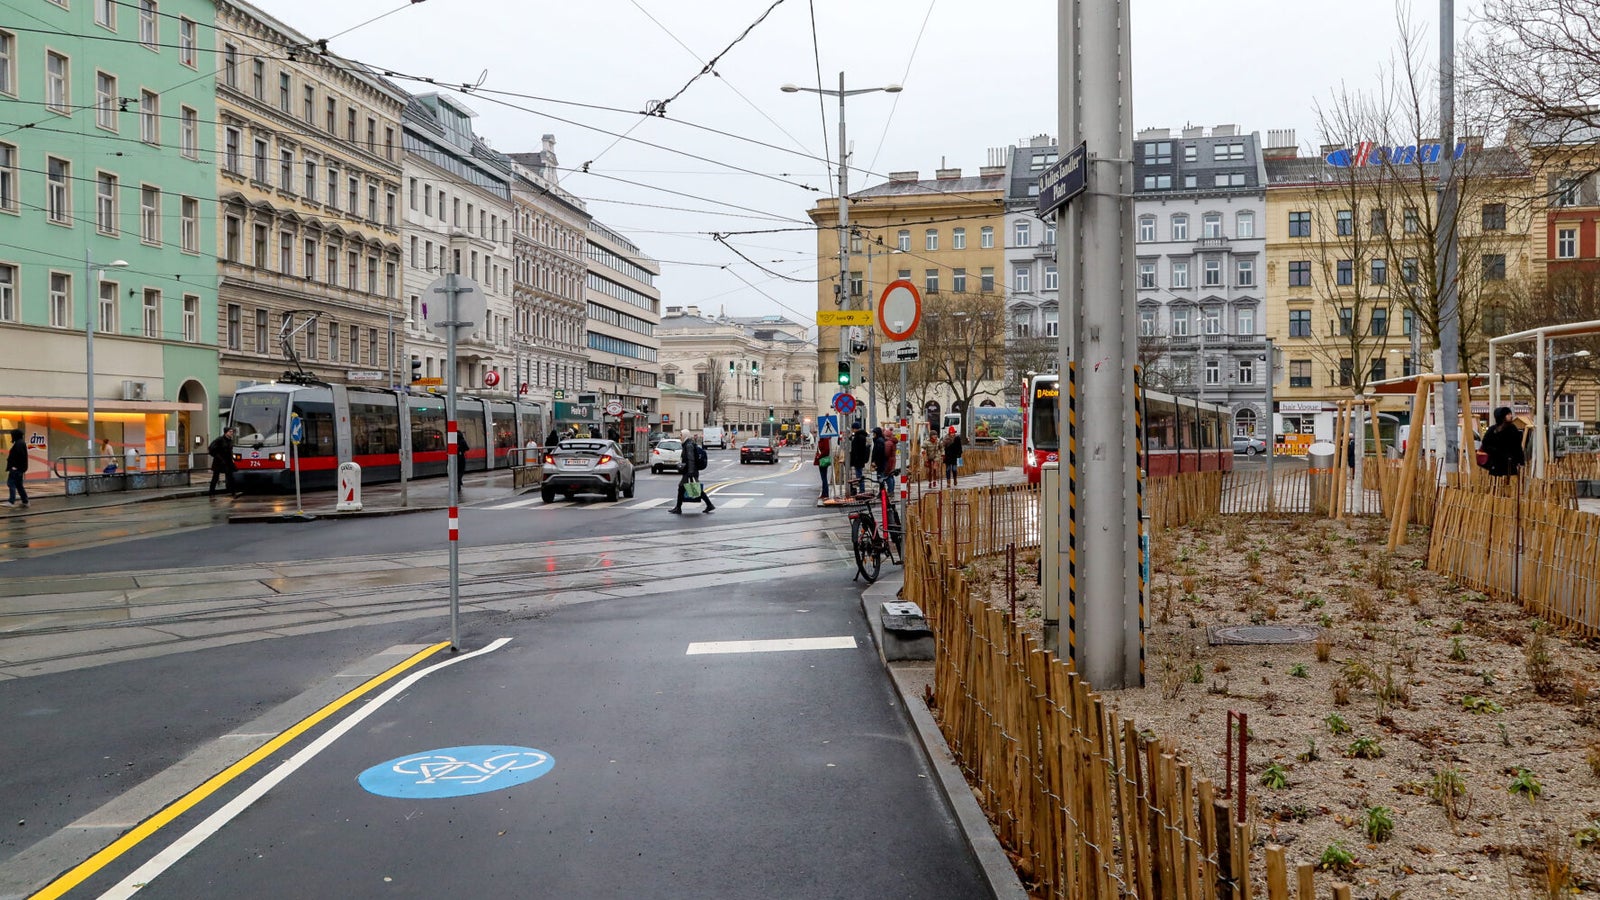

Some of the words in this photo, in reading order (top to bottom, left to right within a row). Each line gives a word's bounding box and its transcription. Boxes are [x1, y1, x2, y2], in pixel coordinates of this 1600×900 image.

[1037, 389, 1042, 398] D
[30, 432, 45, 444] dm
[250, 460, 261, 468] 724
